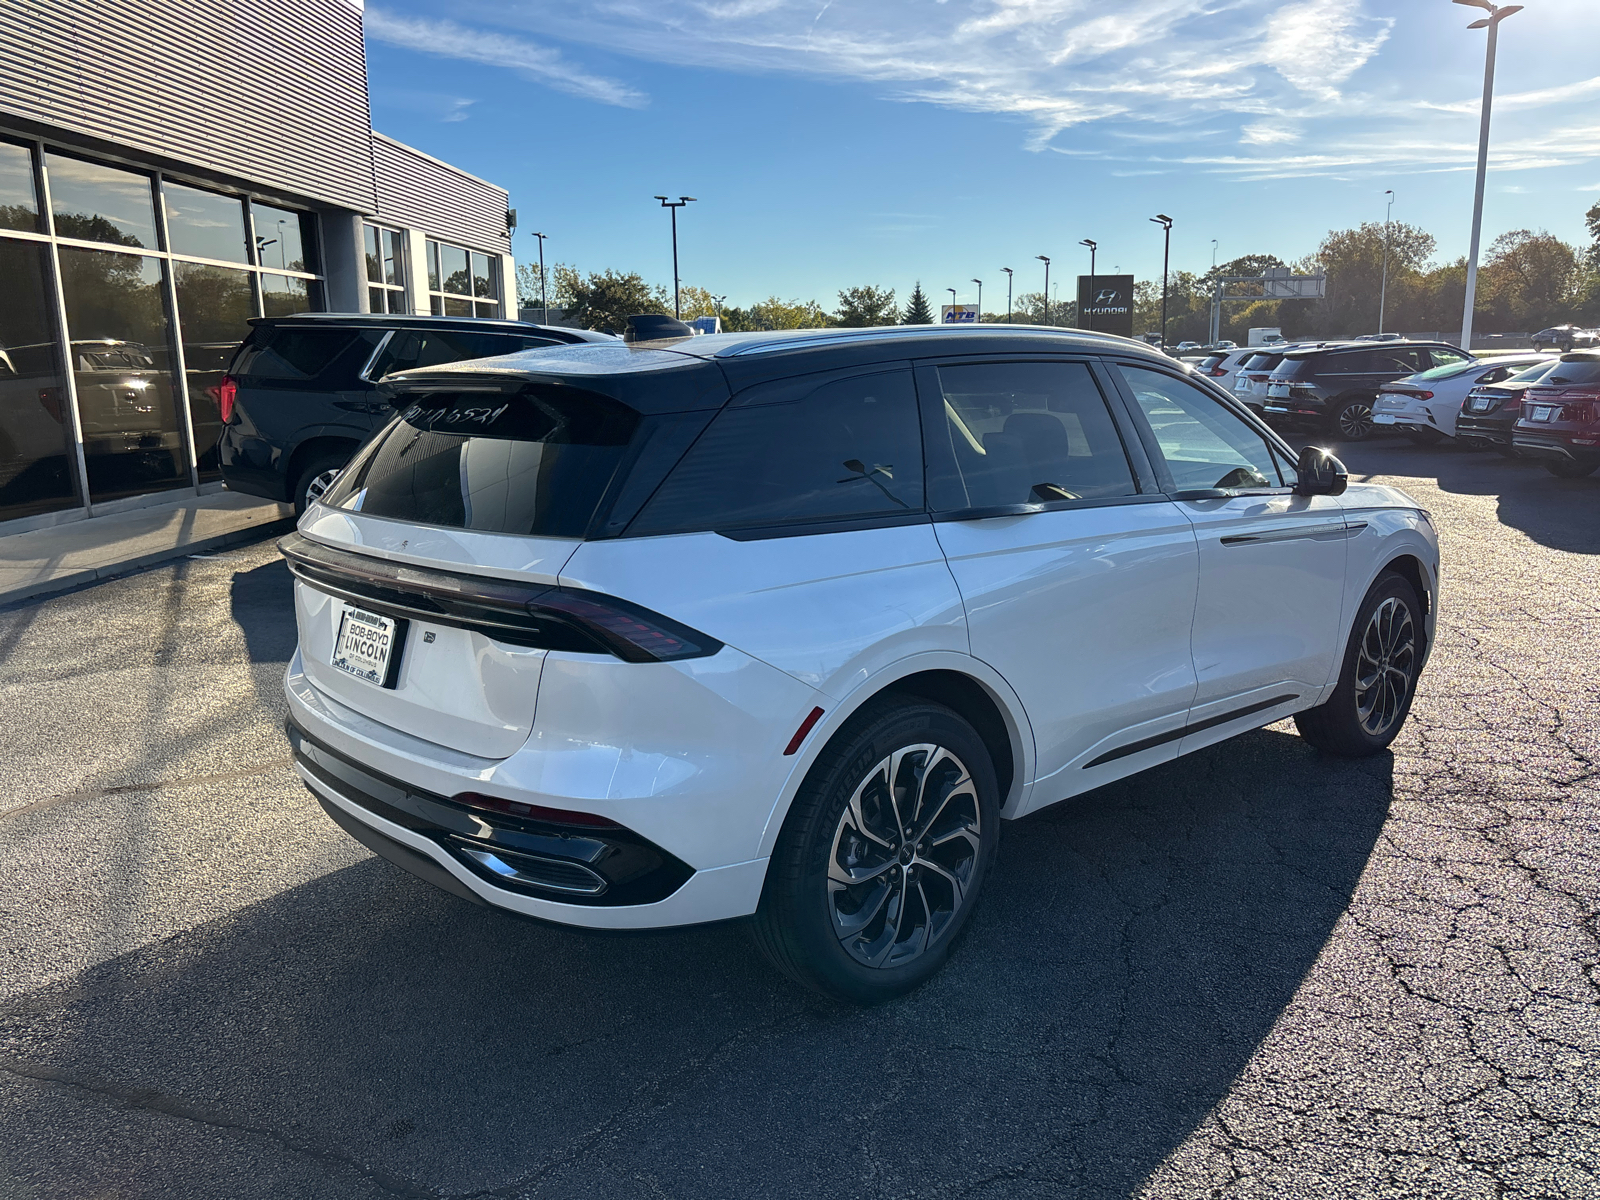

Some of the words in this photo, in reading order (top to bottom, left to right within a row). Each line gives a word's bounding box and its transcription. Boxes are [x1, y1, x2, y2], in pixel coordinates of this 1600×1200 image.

[1084, 307, 1127, 315] HYUNDAI
[350, 624, 388, 645] BOB-BOYD
[345, 635, 387, 662] LINCOLN
[821, 748, 873, 840] MICHELIN
